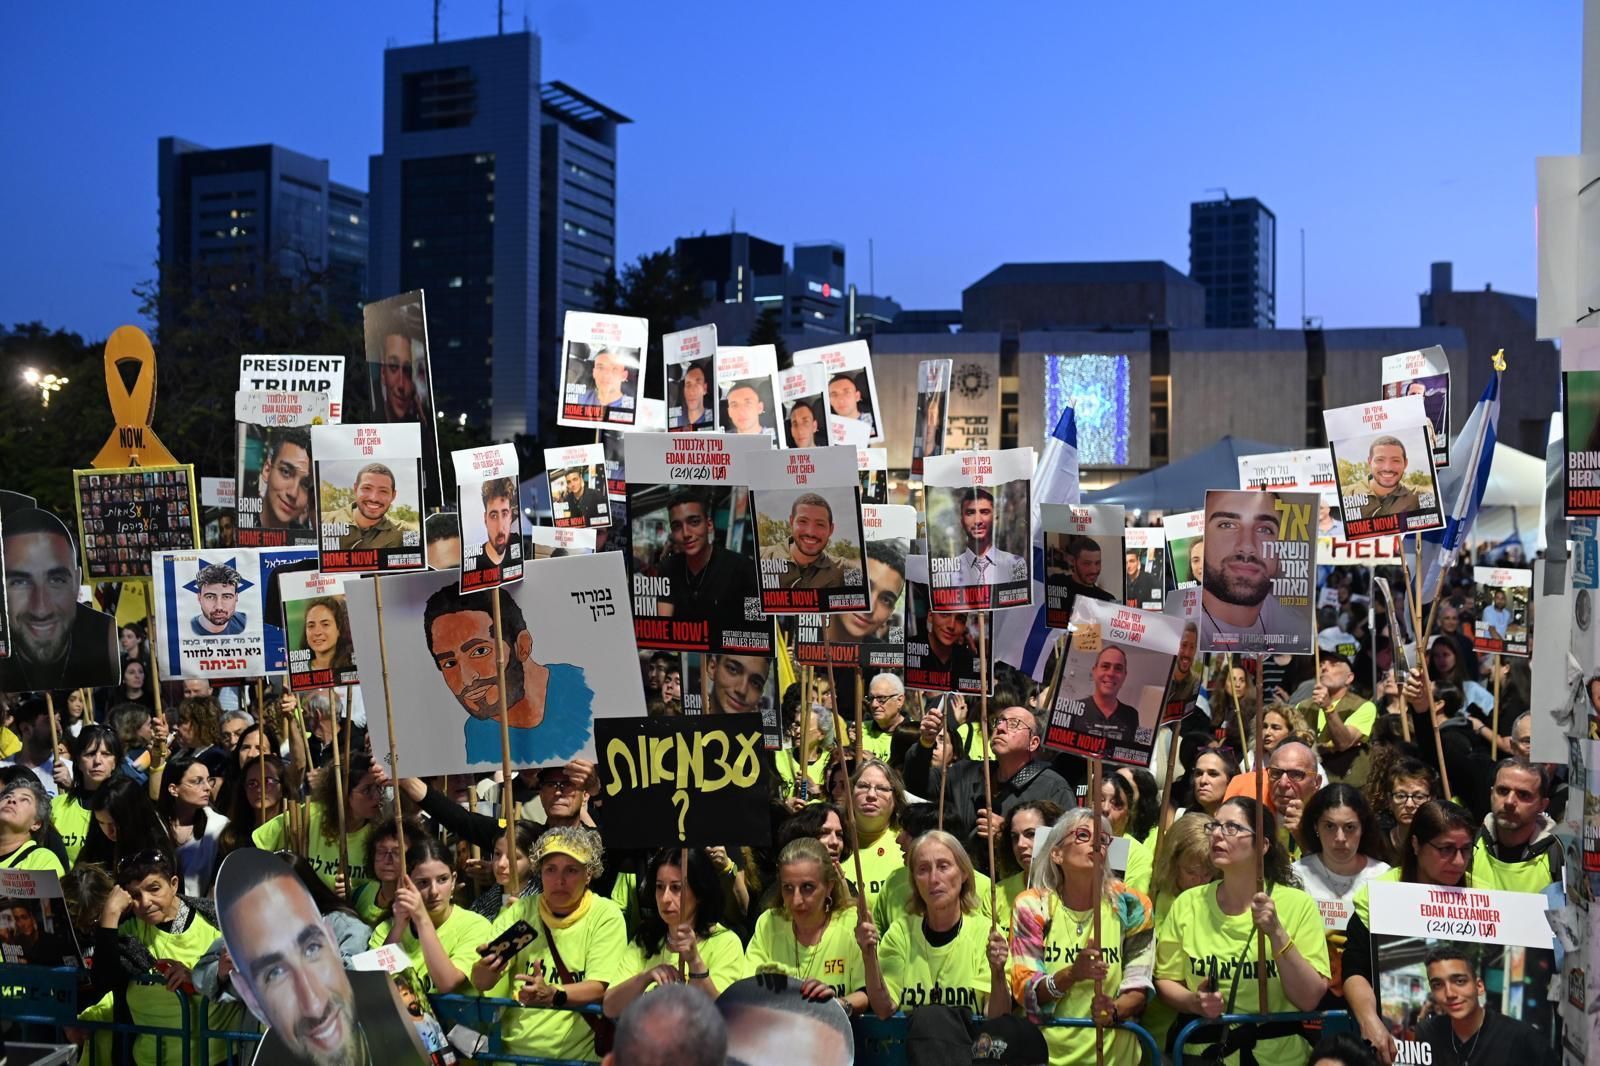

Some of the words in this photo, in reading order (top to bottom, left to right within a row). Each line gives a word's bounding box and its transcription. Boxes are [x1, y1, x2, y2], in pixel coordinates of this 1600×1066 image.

[242, 359, 342, 372] PRESIDENT
[251, 379, 331, 392] TRUMP
[262, 405, 275, 413] EDAN
[275, 405, 303, 414] ALEXANDER
[565, 405, 583, 415] HOME
[584, 406, 604, 417] NOW!
[1362, 414, 1374, 424] ITAY
[1374, 412, 1388, 422] CHEN
[119, 427, 146, 449] NOW.
[353, 437, 366, 446] ITAY
[366, 437, 381, 446] CHEN
[672, 438, 705, 452] אלכסנדר
[706, 438, 723, 453] עידן
[665, 452, 686, 465] EDAN
[687, 452, 731, 466] ALEXANDER
[786, 464, 799, 475] ITAY
[799, 464, 815, 474] CHEN
[978, 465, 993, 475] JOSHI
[795, 474, 807, 485] (19)
[1569, 470, 1592, 488] HER
[239, 497, 263, 512] BRING
[1343, 493, 1369, 509] BRING
[239, 513, 254, 528] HIM
[1080, 516, 1092, 524] CHEN
[1274, 498, 1312, 541] אל
[1344, 506, 1362, 520] HIM
[556, 517, 570, 527] HOME
[570, 516, 586, 526] NOW!
[1347, 519, 1372, 535] HOME
[1372, 513, 1399, 531] NOW!
[321, 522, 350, 537] BRING
[239, 530, 261, 545] HOME
[263, 530, 288, 546] NOW!
[321, 537, 340, 550] HIM
[464, 545, 484, 558] BRING
[1262, 541, 1310, 559] תשאירו
[322, 552, 349, 567] HOME
[351, 549, 378, 566] NOW!
[464, 557, 477, 572] HIM
[931, 557, 961, 573] BRING
[761, 558, 789, 574] BRING
[1281, 559, 1309, 578] אותי
[463, 568, 482, 585] HOME
[482, 566, 501, 583] NOW!
[762, 574, 780, 589] HIM
[932, 572, 951, 588] HIM
[633, 574, 671, 597] BRING
[1048, 585, 1067, 597] BRING
[1270, 578, 1309, 597] מאחור
[571, 587, 613, 604] נמרוד
[764, 590, 791, 606] HOME
[791, 588, 819, 606] NOW!
[933, 588, 961, 605] HOME
[962, 585, 990, 603] NOW!
[589, 602, 616, 622] כהן
[634, 597, 658, 617] HIM
[1118, 609, 1131, 621] עידן
[1131, 612, 1142, 623] צחי
[635, 618, 669, 640] HOME
[672, 620, 709, 643] NOW!
[1110, 617, 1131, 631] TSACHI
[1131, 622, 1146, 634] IDAN
[798, 627, 818, 643] HIM
[1109, 629, 1128, 641] (50)
[722, 637, 748, 648] FAMILIES
[748, 638, 769, 649] FORUM
[906, 642, 929, 657] BRING
[183, 646, 214, 659] לחזור
[216, 648, 242, 657] רוצה
[244, 646, 262, 657] גיא
[290, 649, 311, 662] BRING
[798, 644, 828, 661] HOME
[828, 645, 860, 662] NOW!
[199, 658, 248, 671] הביתה
[906, 656, 921, 668] HIM
[291, 672, 311, 686] HOME
[312, 668, 333, 684] NOW!
[906, 670, 928, 685] HOME
[928, 671, 950, 686] NOW!
[1055, 697, 1086, 717] BRING
[1052, 712, 1071, 728] HIM
[1049, 728, 1077, 745] HOME
[1077, 731, 1107, 752] NOW!
[605, 729, 763, 798] עצמאות
[671, 788, 690, 842] ?
[1428, 889, 1468, 906] אלכסנדר
[1469, 894, 1490, 908] עידן
[1327, 910, 1348, 919] GODARD
[1420, 903, 1445, 918] EDAN
[1447, 905, 1501, 923] ALEXANDER
[2, 943, 24, 957] BRING
[1045, 941, 1061, 963] לב
[824, 959, 845, 975] 575
[1396, 1040, 1433, 1066] RING
